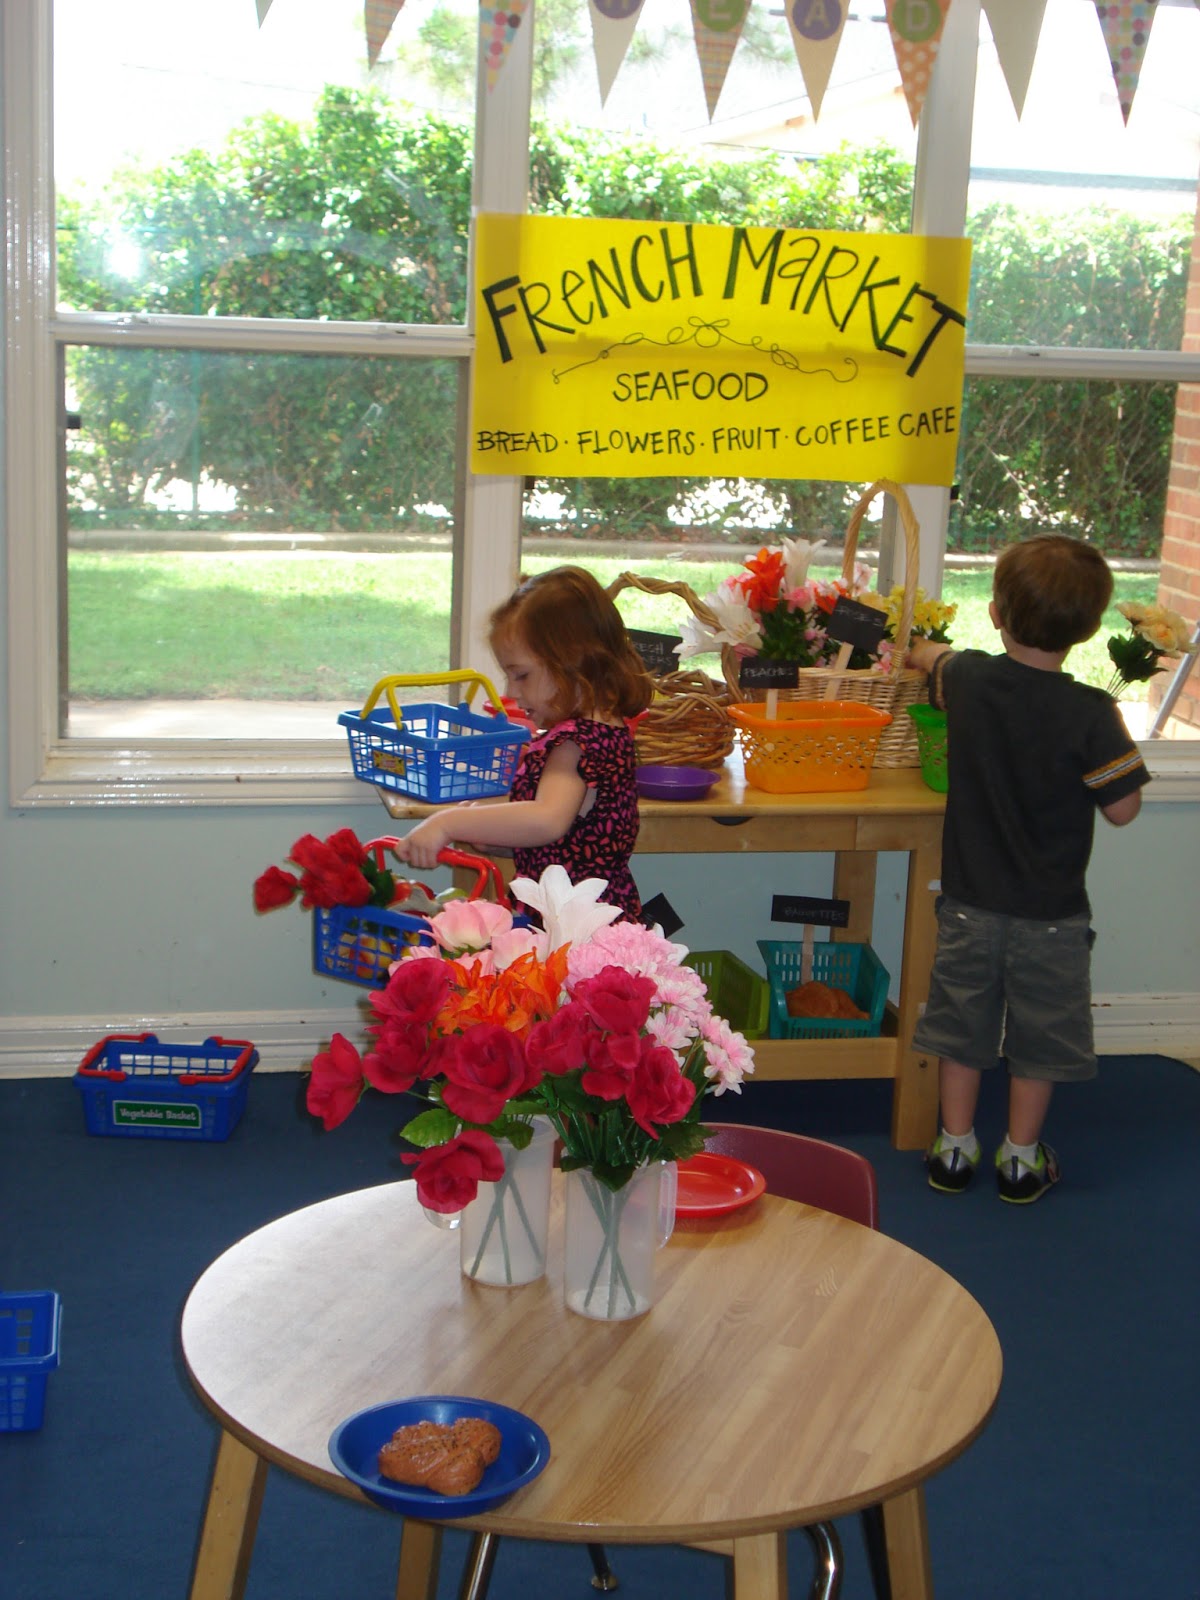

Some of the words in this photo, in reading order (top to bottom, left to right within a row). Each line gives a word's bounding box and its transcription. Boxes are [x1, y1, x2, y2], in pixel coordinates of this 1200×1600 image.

[612, 369, 769, 402] SEAFOOD
[477, 430, 558, 453] BREAD
[713, 426, 782, 453] FRUIT
[796, 416, 890, 447] COFFEE
[897, 406, 956, 437] CAFE
[119, 1107, 164, 1121] Vegetable
[165, 1109, 197, 1121] Basket
